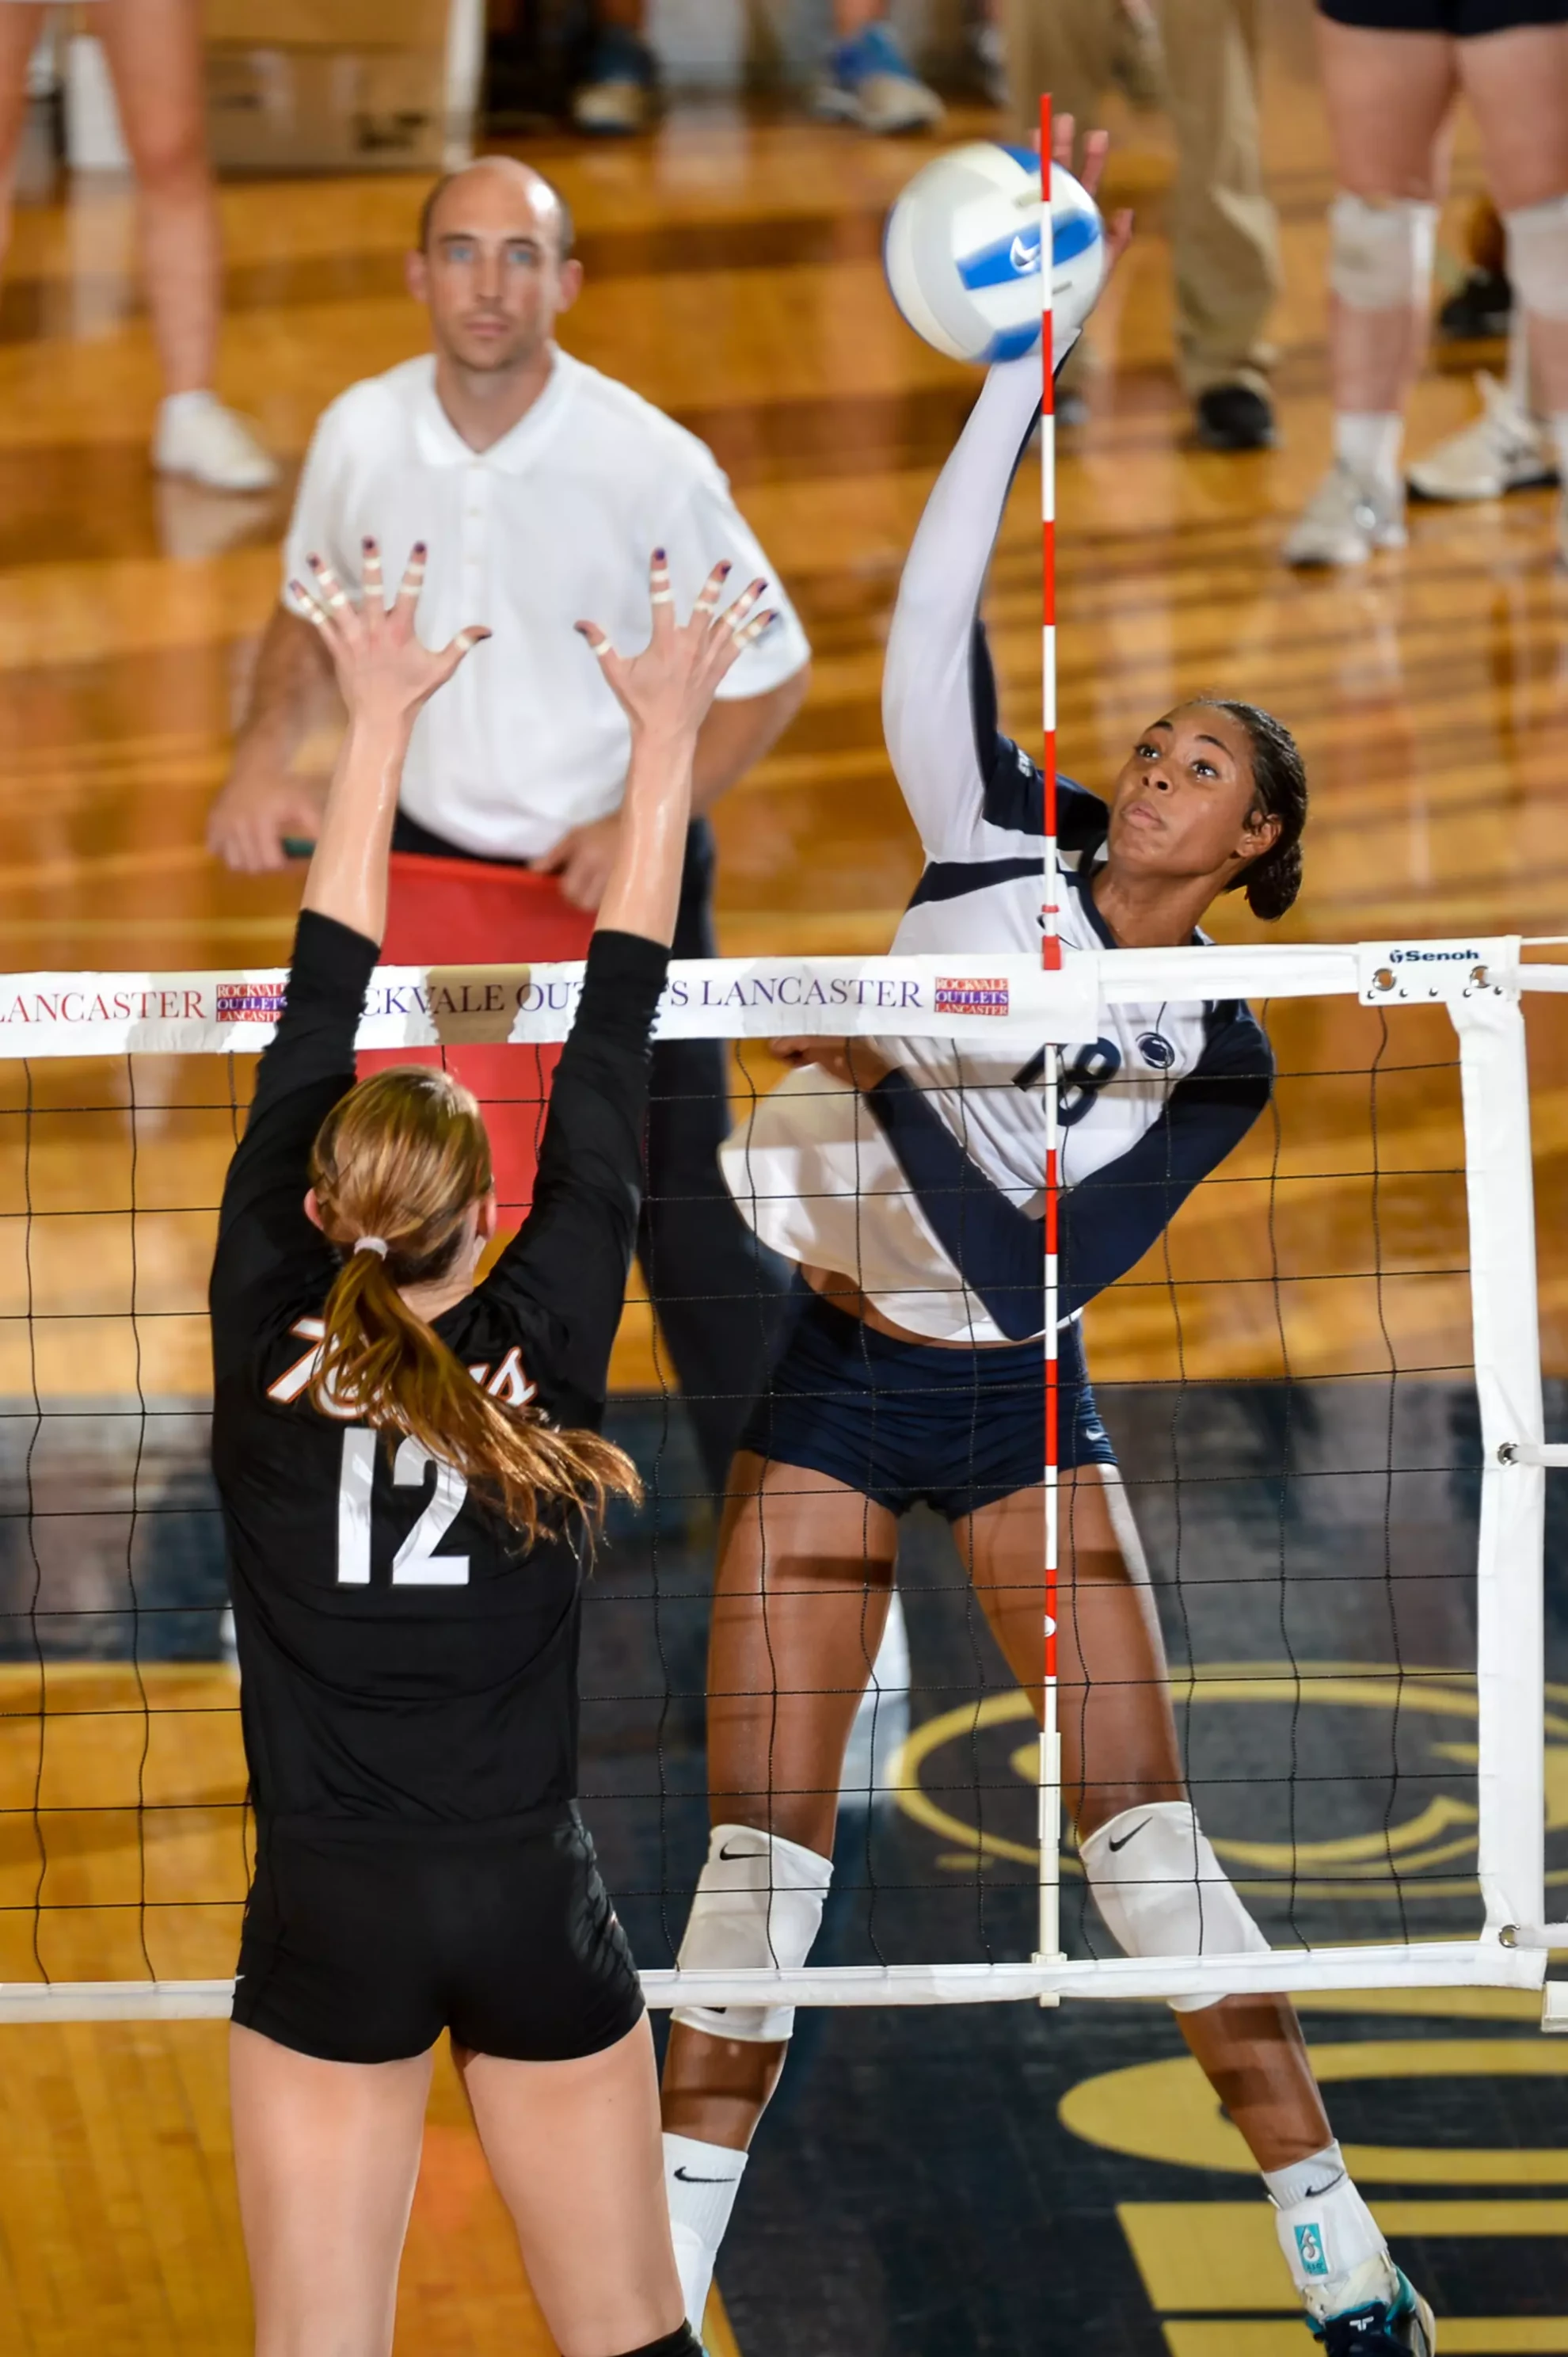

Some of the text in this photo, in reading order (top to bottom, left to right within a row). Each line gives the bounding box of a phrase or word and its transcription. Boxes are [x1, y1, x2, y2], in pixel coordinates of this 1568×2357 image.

[1405, 950, 1479, 961] Senoh
[936, 977, 1009, 991] ROCKVALE
[361, 983, 505, 1017] CKVALE
[700, 977, 924, 1009] LANCASTER
[935, 990, 1009, 1004] OUTLETS
[0, 990, 207, 1022] ANCASTER
[935, 1003, 1009, 1016] LANCASTER
[217, 1010, 283, 1022] LANCASTE
[337, 1426, 470, 1585] 12
